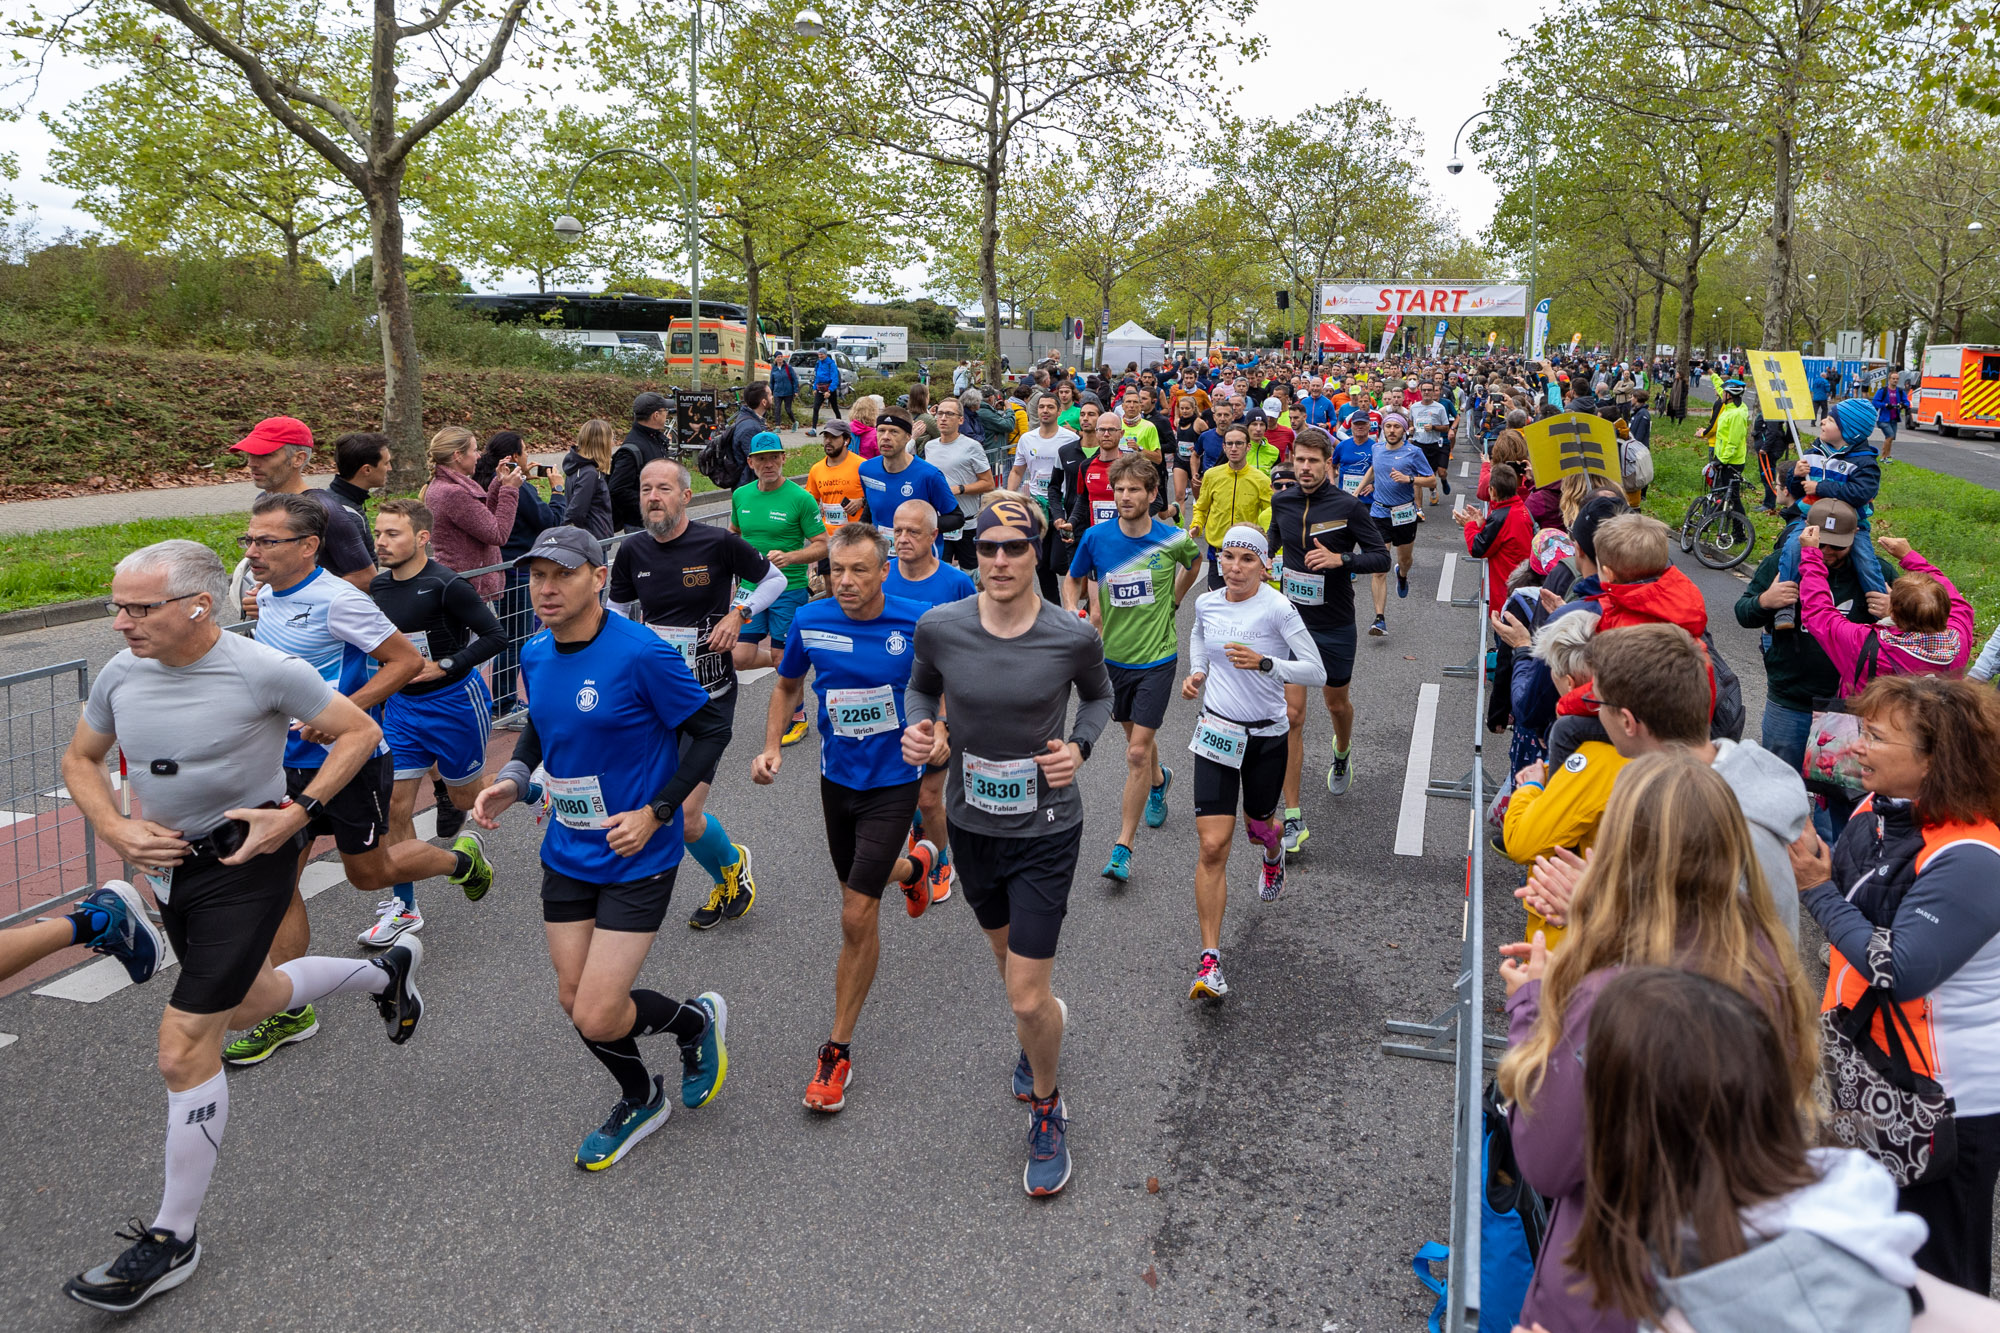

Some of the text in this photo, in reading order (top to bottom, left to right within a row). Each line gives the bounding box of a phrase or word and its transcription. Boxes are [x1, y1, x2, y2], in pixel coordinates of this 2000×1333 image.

[1376, 288, 1469, 313] START
[1388, 314, 1398, 327] A
[1438, 321, 1446, 332] B
[680, 394, 713, 402] ruminate
[1100, 510, 1114, 518] 657
[1397, 510, 1412, 520] 3324
[683, 572, 711, 588] 08
[1118, 584, 1140, 598] 678
[1290, 582, 1314, 597] 3155
[1121, 598, 1140, 606] Michael
[841, 707, 881, 723] 2266
[853, 727, 874, 735] Ulrich
[1202, 730, 1233, 753] 2985
[976, 779, 1020, 799] 3830
[979, 801, 1018, 812] Lars Fabian
